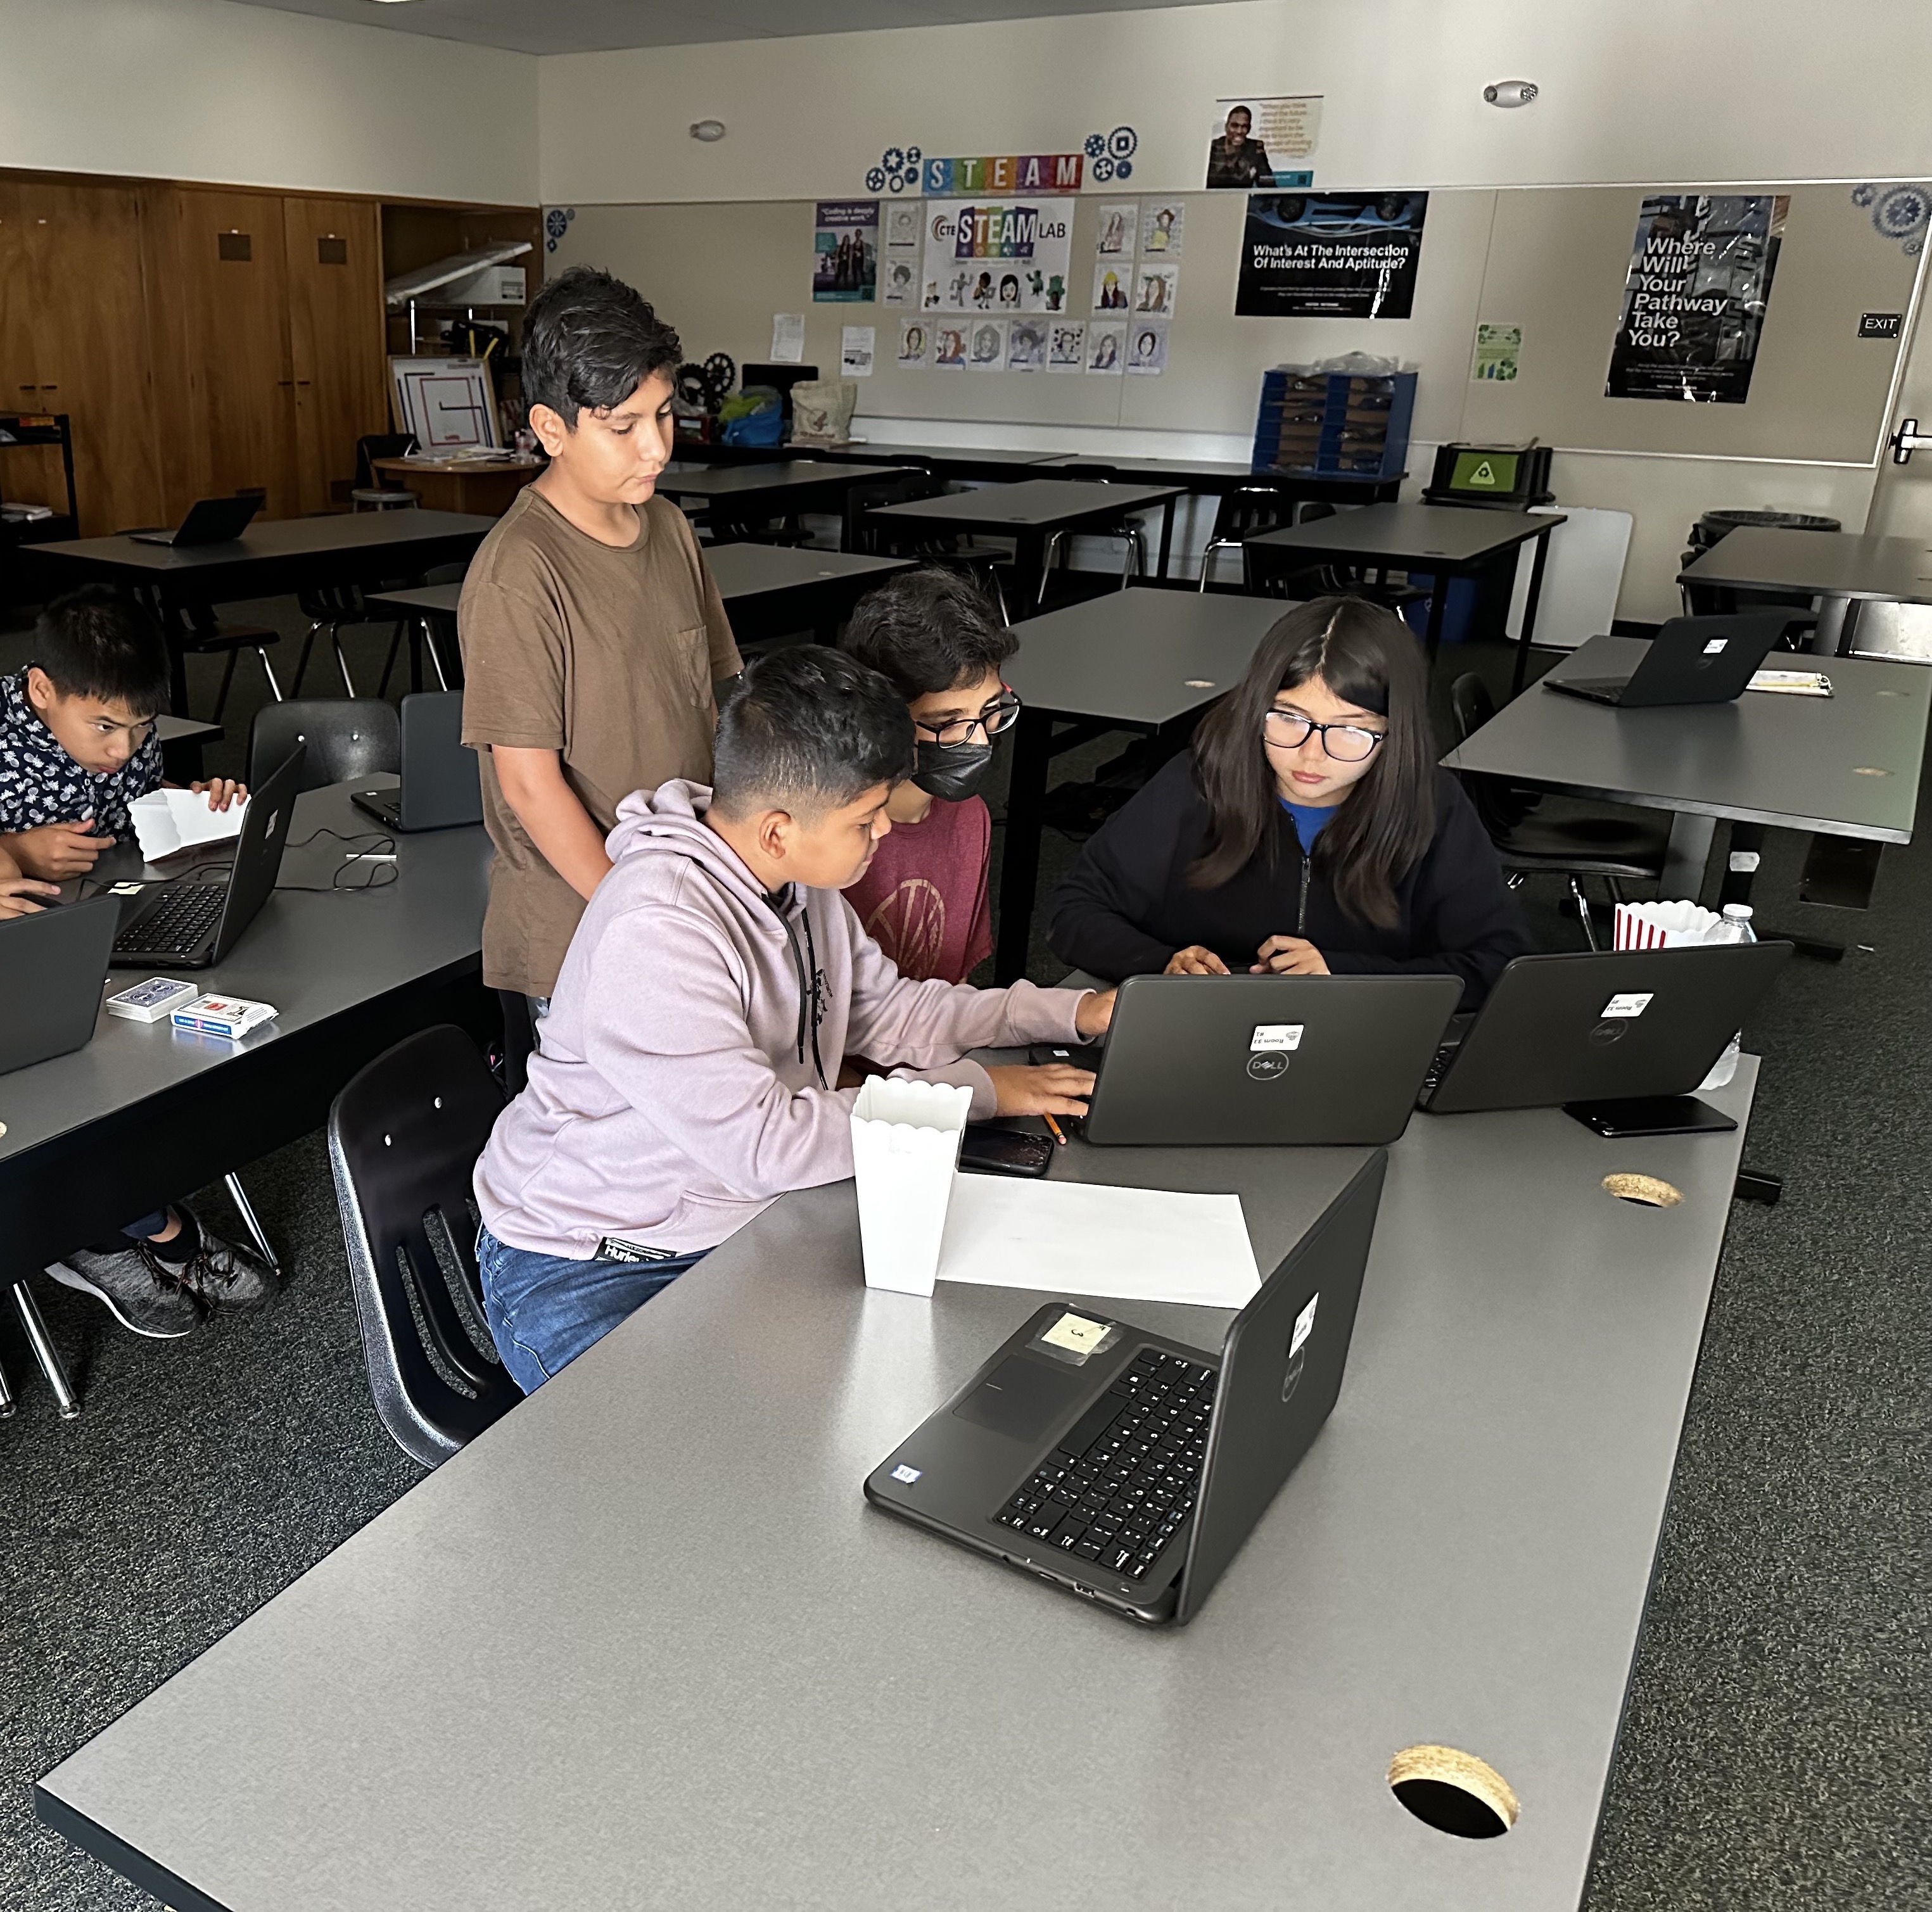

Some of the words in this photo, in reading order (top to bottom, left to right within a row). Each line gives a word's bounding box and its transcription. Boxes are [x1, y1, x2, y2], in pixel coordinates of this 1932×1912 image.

[931, 157, 1077, 188] STEAM
[940, 224, 956, 236] CTE
[959, 213, 1037, 244] STEAM
[1039, 222, 1066, 239] LAB
[1253, 244, 1293, 256] What's
[1293, 244, 1309, 256] At
[1311, 244, 1333, 256] The
[1335, 244, 1409, 256] Intersection
[1647, 237, 1717, 255] Where
[1254, 256, 1269, 269] Of
[1270, 257, 1316, 269] Interest
[1318, 258, 1344, 269] And
[1345, 257, 1406, 272] Aptitude?
[1643, 256, 1684, 274] Will
[1640, 274, 1687, 292] Your
[1634, 293, 1729, 316] Pathway
[1632, 311, 1679, 329] Take
[1865, 319, 1898, 329] EXIT
[1629, 329, 1681, 347] You?
[1252, 1061, 1283, 1070] DELL
[604, 1245, 640, 1262] Hurle
